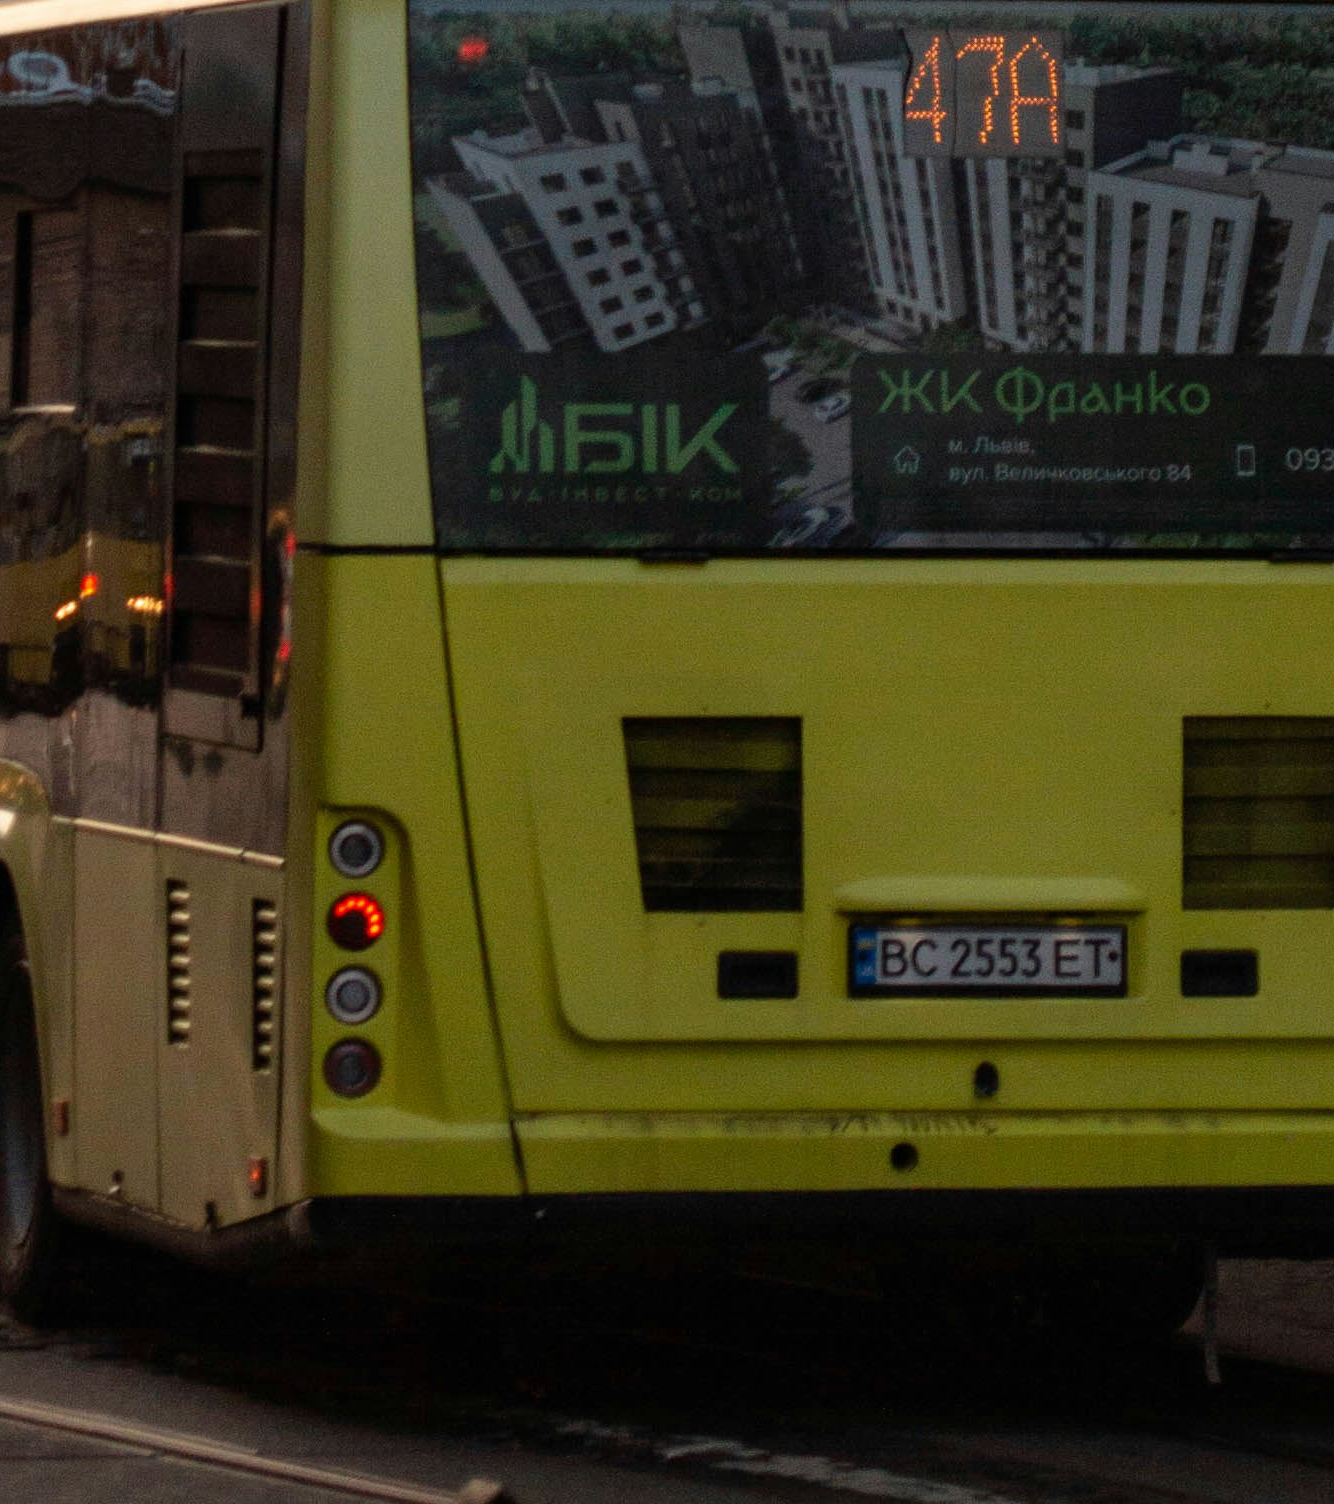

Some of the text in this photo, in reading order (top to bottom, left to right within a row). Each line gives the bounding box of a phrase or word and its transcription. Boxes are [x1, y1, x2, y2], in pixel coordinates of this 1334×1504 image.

[905, 35, 1060, 146] 47А
[877, 365, 1212, 425] ЖК Франко
[562, 401, 741, 476] БІК
[947, 435, 1037, 457] м. Львів,
[947, 462, 1193, 485] вул. Величковського 84
[880, 938, 1111, 978] BC 2553 ET
